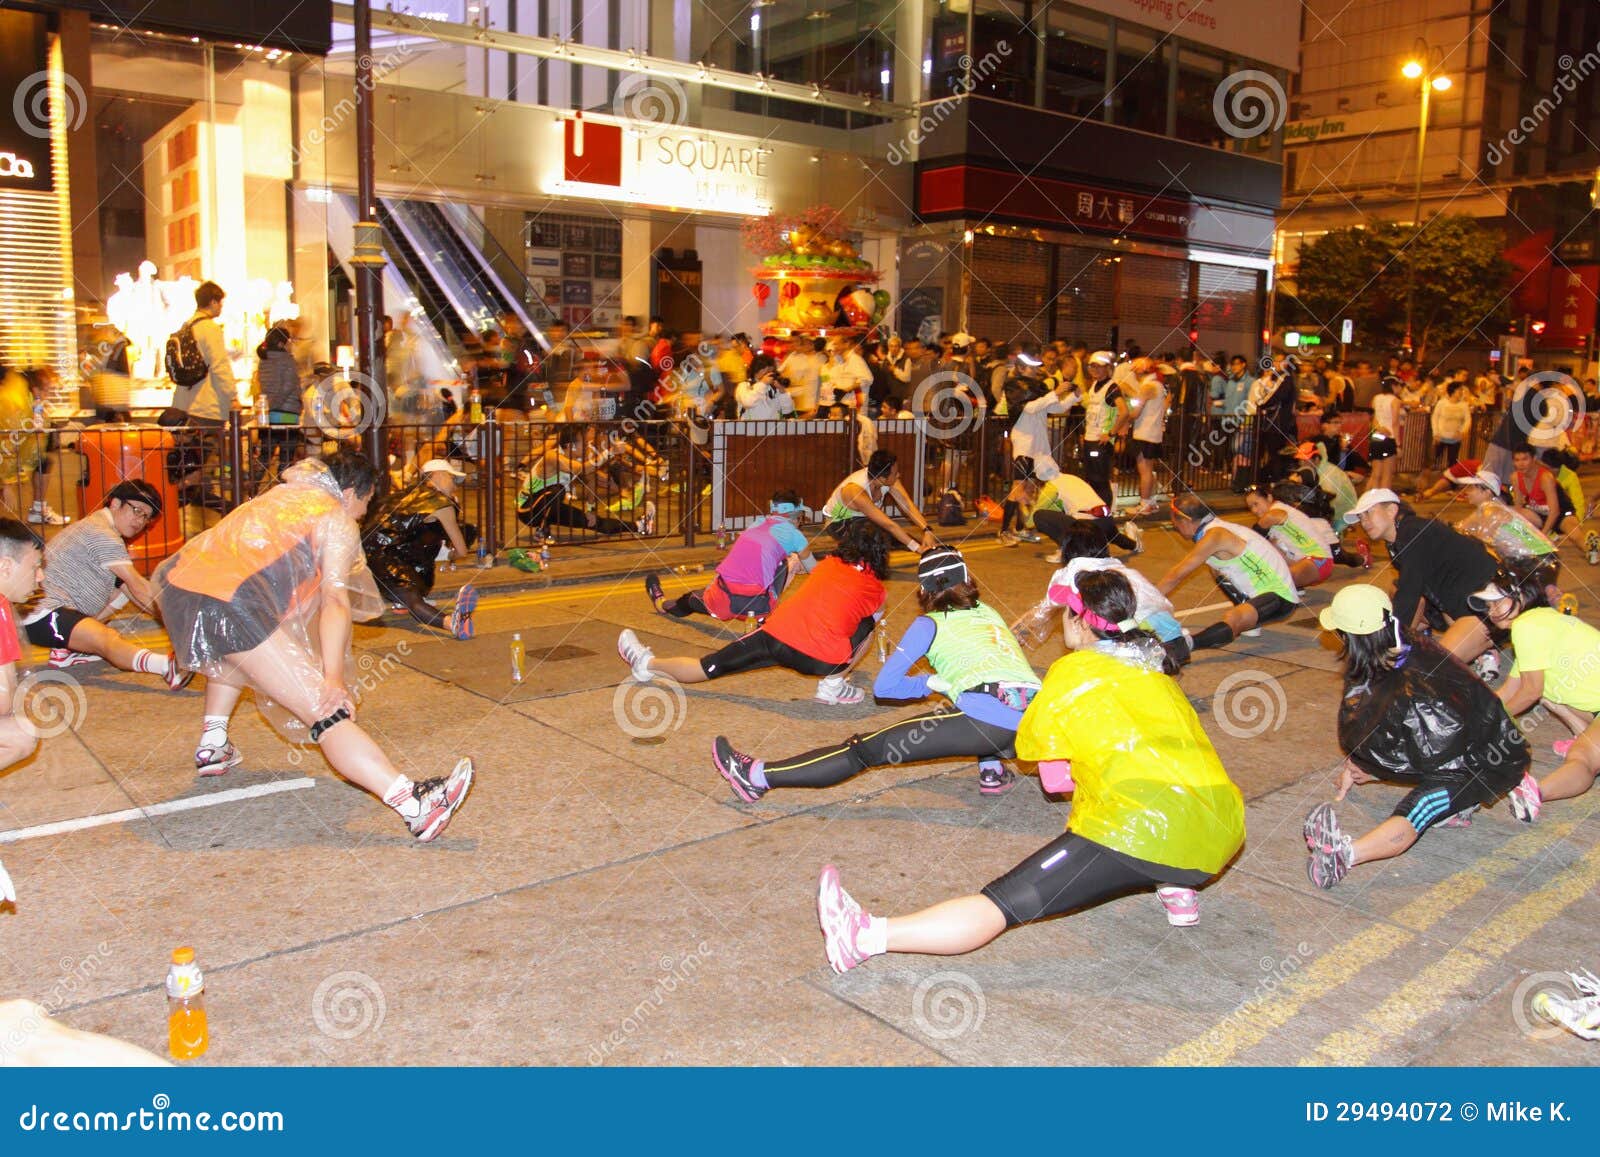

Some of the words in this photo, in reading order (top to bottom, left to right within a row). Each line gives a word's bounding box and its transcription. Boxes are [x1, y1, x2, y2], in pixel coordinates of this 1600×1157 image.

[1177, 1, 1217, 30] Centre
[1322, 119, 1345, 134] Inn
[657, 136, 769, 177] SQUARE
[1076, 191, 1134, 224] 周大福
